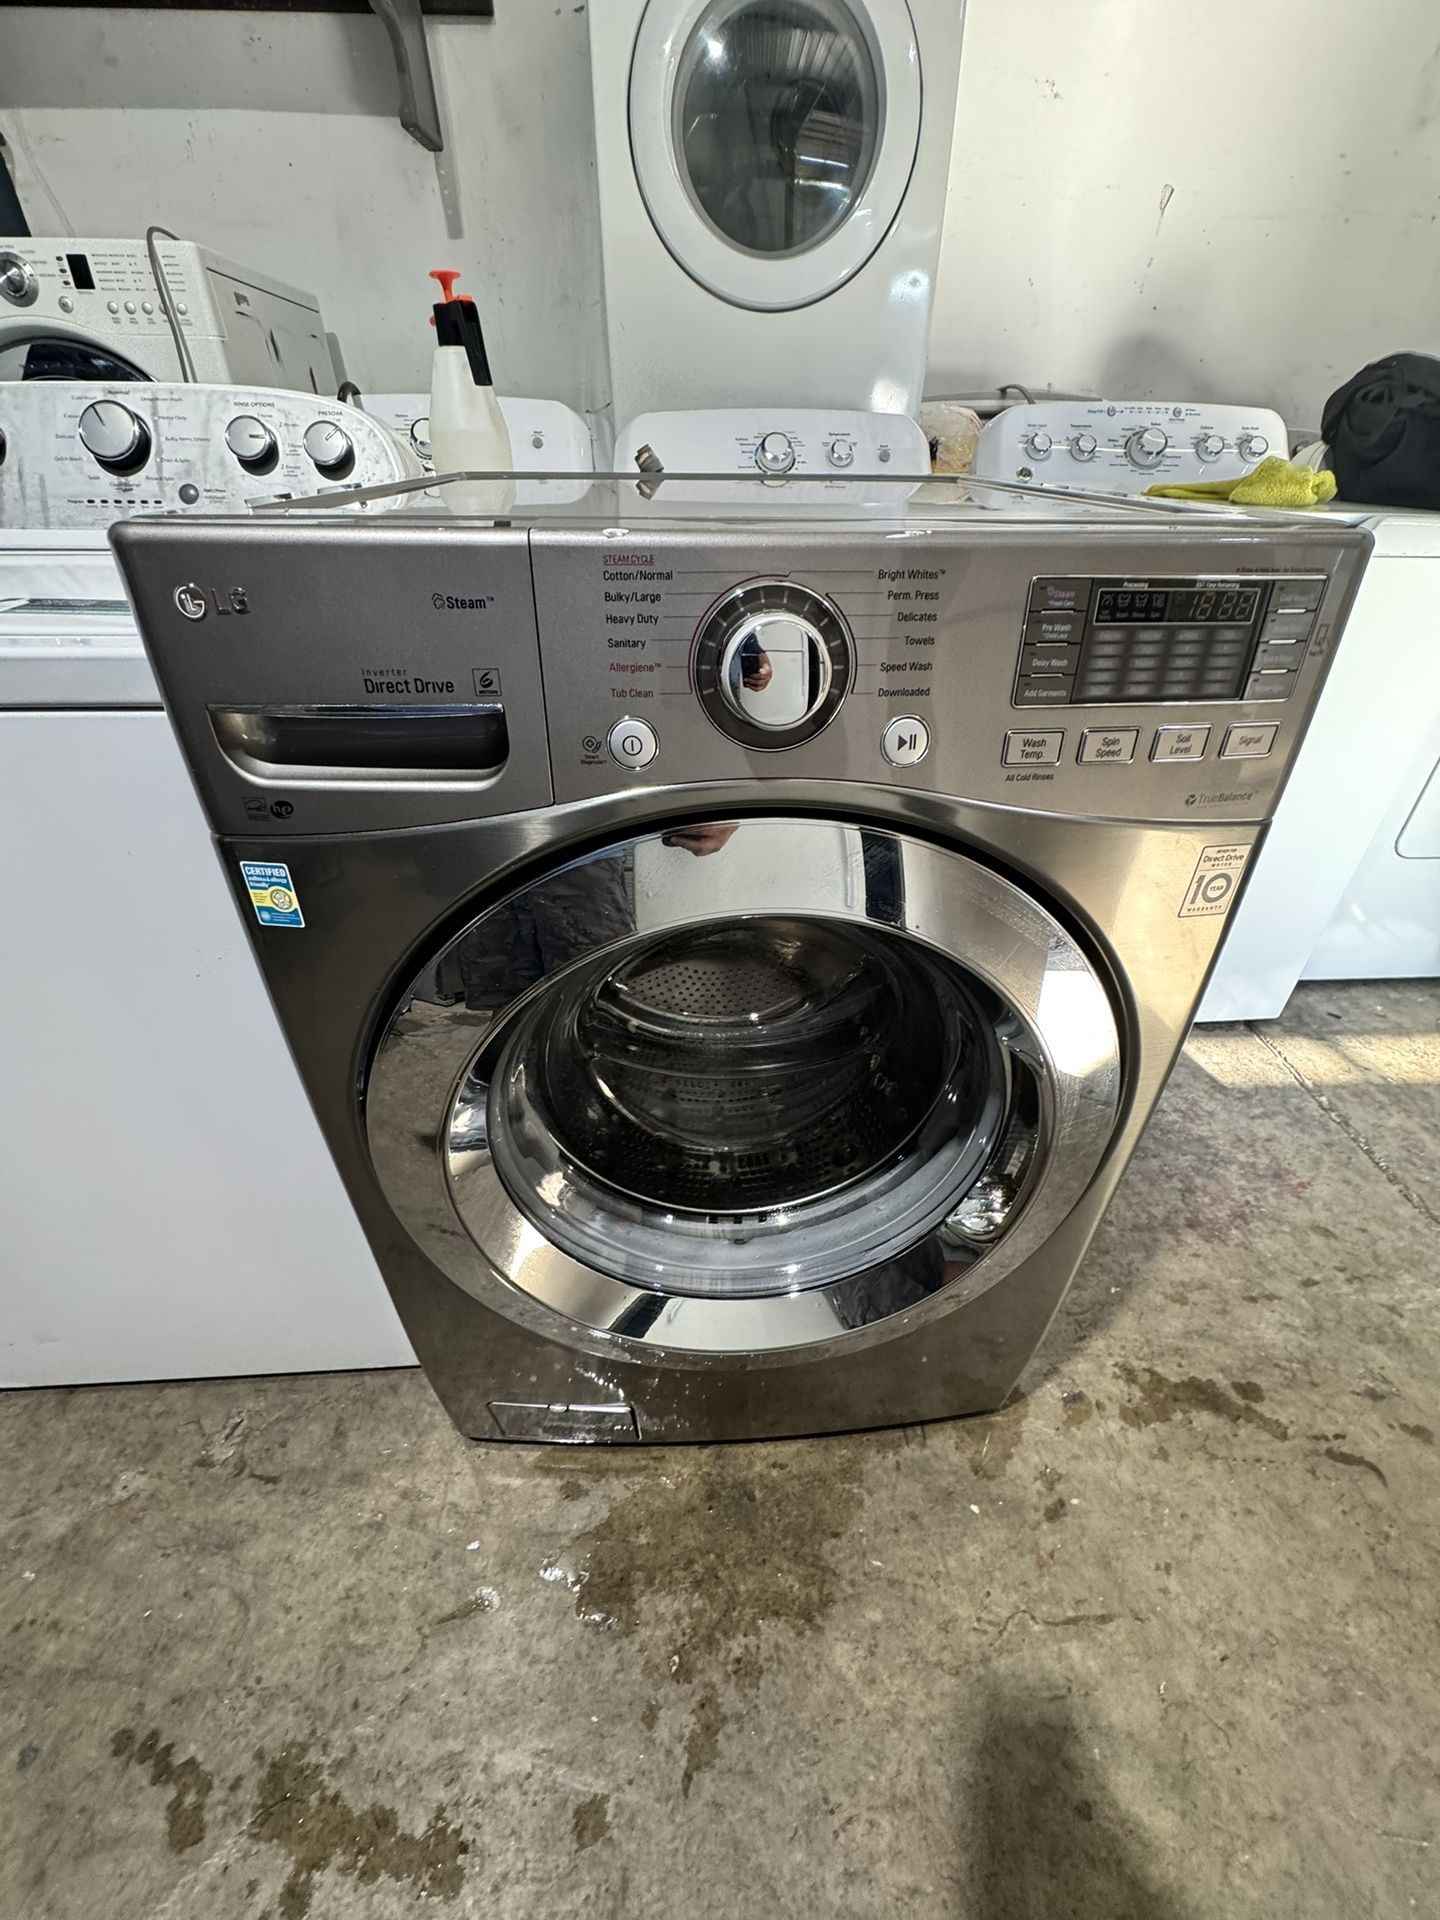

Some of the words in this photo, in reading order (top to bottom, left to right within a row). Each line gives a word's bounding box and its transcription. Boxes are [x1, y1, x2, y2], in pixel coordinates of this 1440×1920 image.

[602, 554, 630, 564] STEAM
[630, 554, 655, 564] CYCLE
[603, 570, 674, 581] Cotton/Normal
[878, 568, 906, 581] Bright
[604, 592, 662, 604] Bulky/Large
[887, 589, 913, 601] Perm.
[914, 589, 940, 601] Press
[605, 613, 635, 625] Heavy
[637, 613, 659, 625] Duty
[897, 611, 938, 622] Delicates
[1041, 623, 1054, 632] Pre
[1053, 623, 1073, 632] Wash
[607, 638, 647, 650] Sanitary
[904, 635, 936, 646] Towels
[880, 661, 908, 673] Speed
[908, 661, 934, 671] Wash
[1032, 658, 1050, 668] Delay
[1050, 658, 1069, 668] Wash
[363, 678, 412, 694] Direct
[414, 678, 456, 694] Drive
[611, 688, 628, 698] Tub
[629, 688, 654, 698] Clean
[877, 686, 932, 698] Downloaded
[1024, 689, 1037, 698] Add
[1037, 689, 1068, 698] Garments
[1022, 738, 1047, 748] Wash
[1102, 737, 1121, 749] Spin
[1175, 734, 1192, 745] Soil
[1238, 735, 1264, 747] Signal
[1020, 749, 1046, 760] Temp.
[1095, 748, 1122, 758] Speed
[1169, 745, 1192, 755] Level
[1005, 774, 1016, 782] All
[1015, 773, 1032, 782] Cold
[1031, 773, 1055, 782] Rinses
[1203, 855, 1225, 863] Direct
[1225, 854, 1245, 862] Drive
[244, 866, 287, 878] CERTIFIED
[1189, 872, 1233, 905] 10
